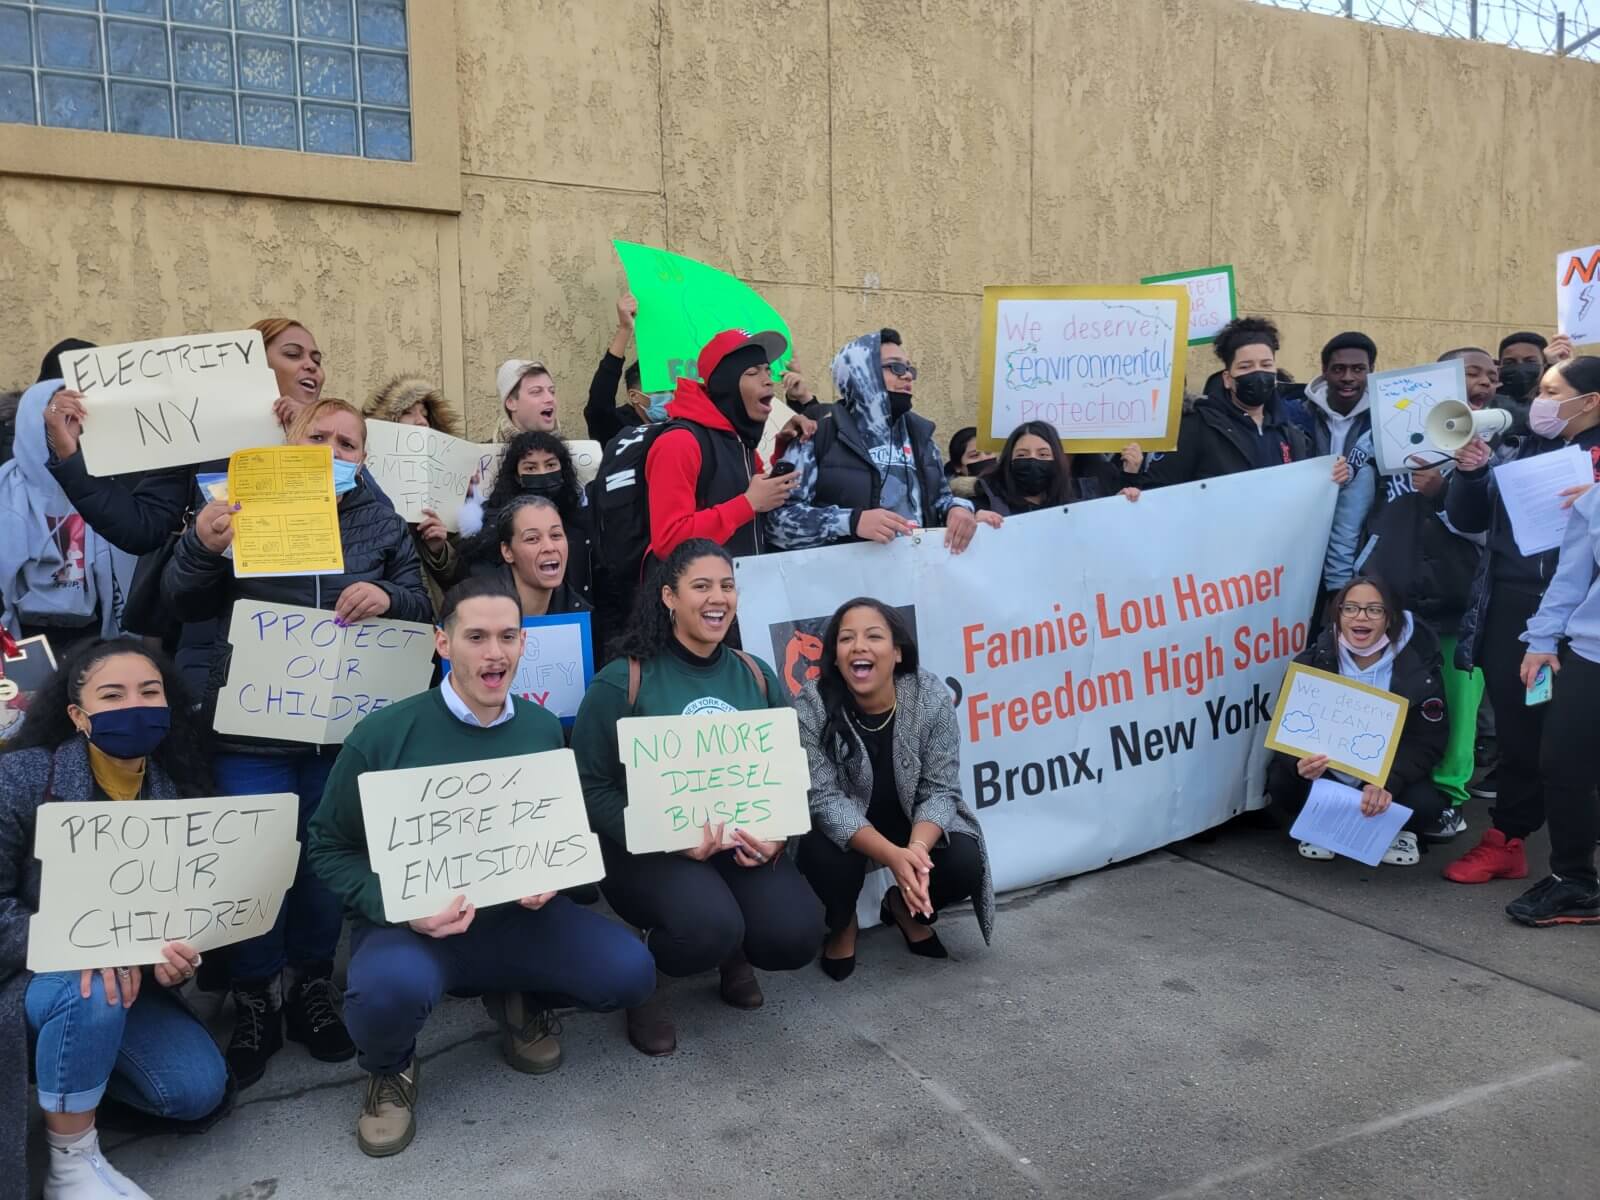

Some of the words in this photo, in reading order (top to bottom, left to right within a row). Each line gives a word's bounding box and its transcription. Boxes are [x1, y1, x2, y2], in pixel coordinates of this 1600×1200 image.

[1004, 312, 1041, 343] We
[1063, 315, 1151, 341] deserve
[73, 339, 255, 394] ELECTRIFY
[1017, 339, 1169, 382] environmental
[135, 397, 200, 446] NY
[395, 431, 457, 457] 100%
[367, 455, 468, 496] EMISSIONS
[251, 611, 427, 650] PROTECT
[962, 603, 1088, 674] Fannie
[1096, 592, 1167, 641] Lou
[1172, 564, 1285, 622] Hamer
[286, 654, 364, 681] OUR
[967, 670, 1134, 743] Freedom
[1143, 635, 1225, 696] High
[1233, 617, 1308, 671] Scho
[238, 683, 396, 721] CHILDRE
[1295, 679, 1321, 698] We
[1335, 693, 1394, 721] deserve
[1307, 703, 1370, 731] CLEAN
[632, 728, 682, 769] NO
[696, 721, 774, 759] MORE
[972, 747, 1104, 810] Bronx,
[1109, 717, 1198, 771] New
[1205, 683, 1272, 741] York
[1306, 731, 1352, 752] AIR
[420, 767, 522, 802] 100%
[661, 762, 783, 796] DIESEL
[61, 808, 278, 853] PROTECT
[387, 804, 501, 852] LIBRE
[509, 797, 563, 828] DE
[664, 799, 773, 832] BUSES
[109, 852, 221, 896] OUR
[401, 834, 588, 901] EMISIONES
[69, 892, 274, 949] CHILDREN
